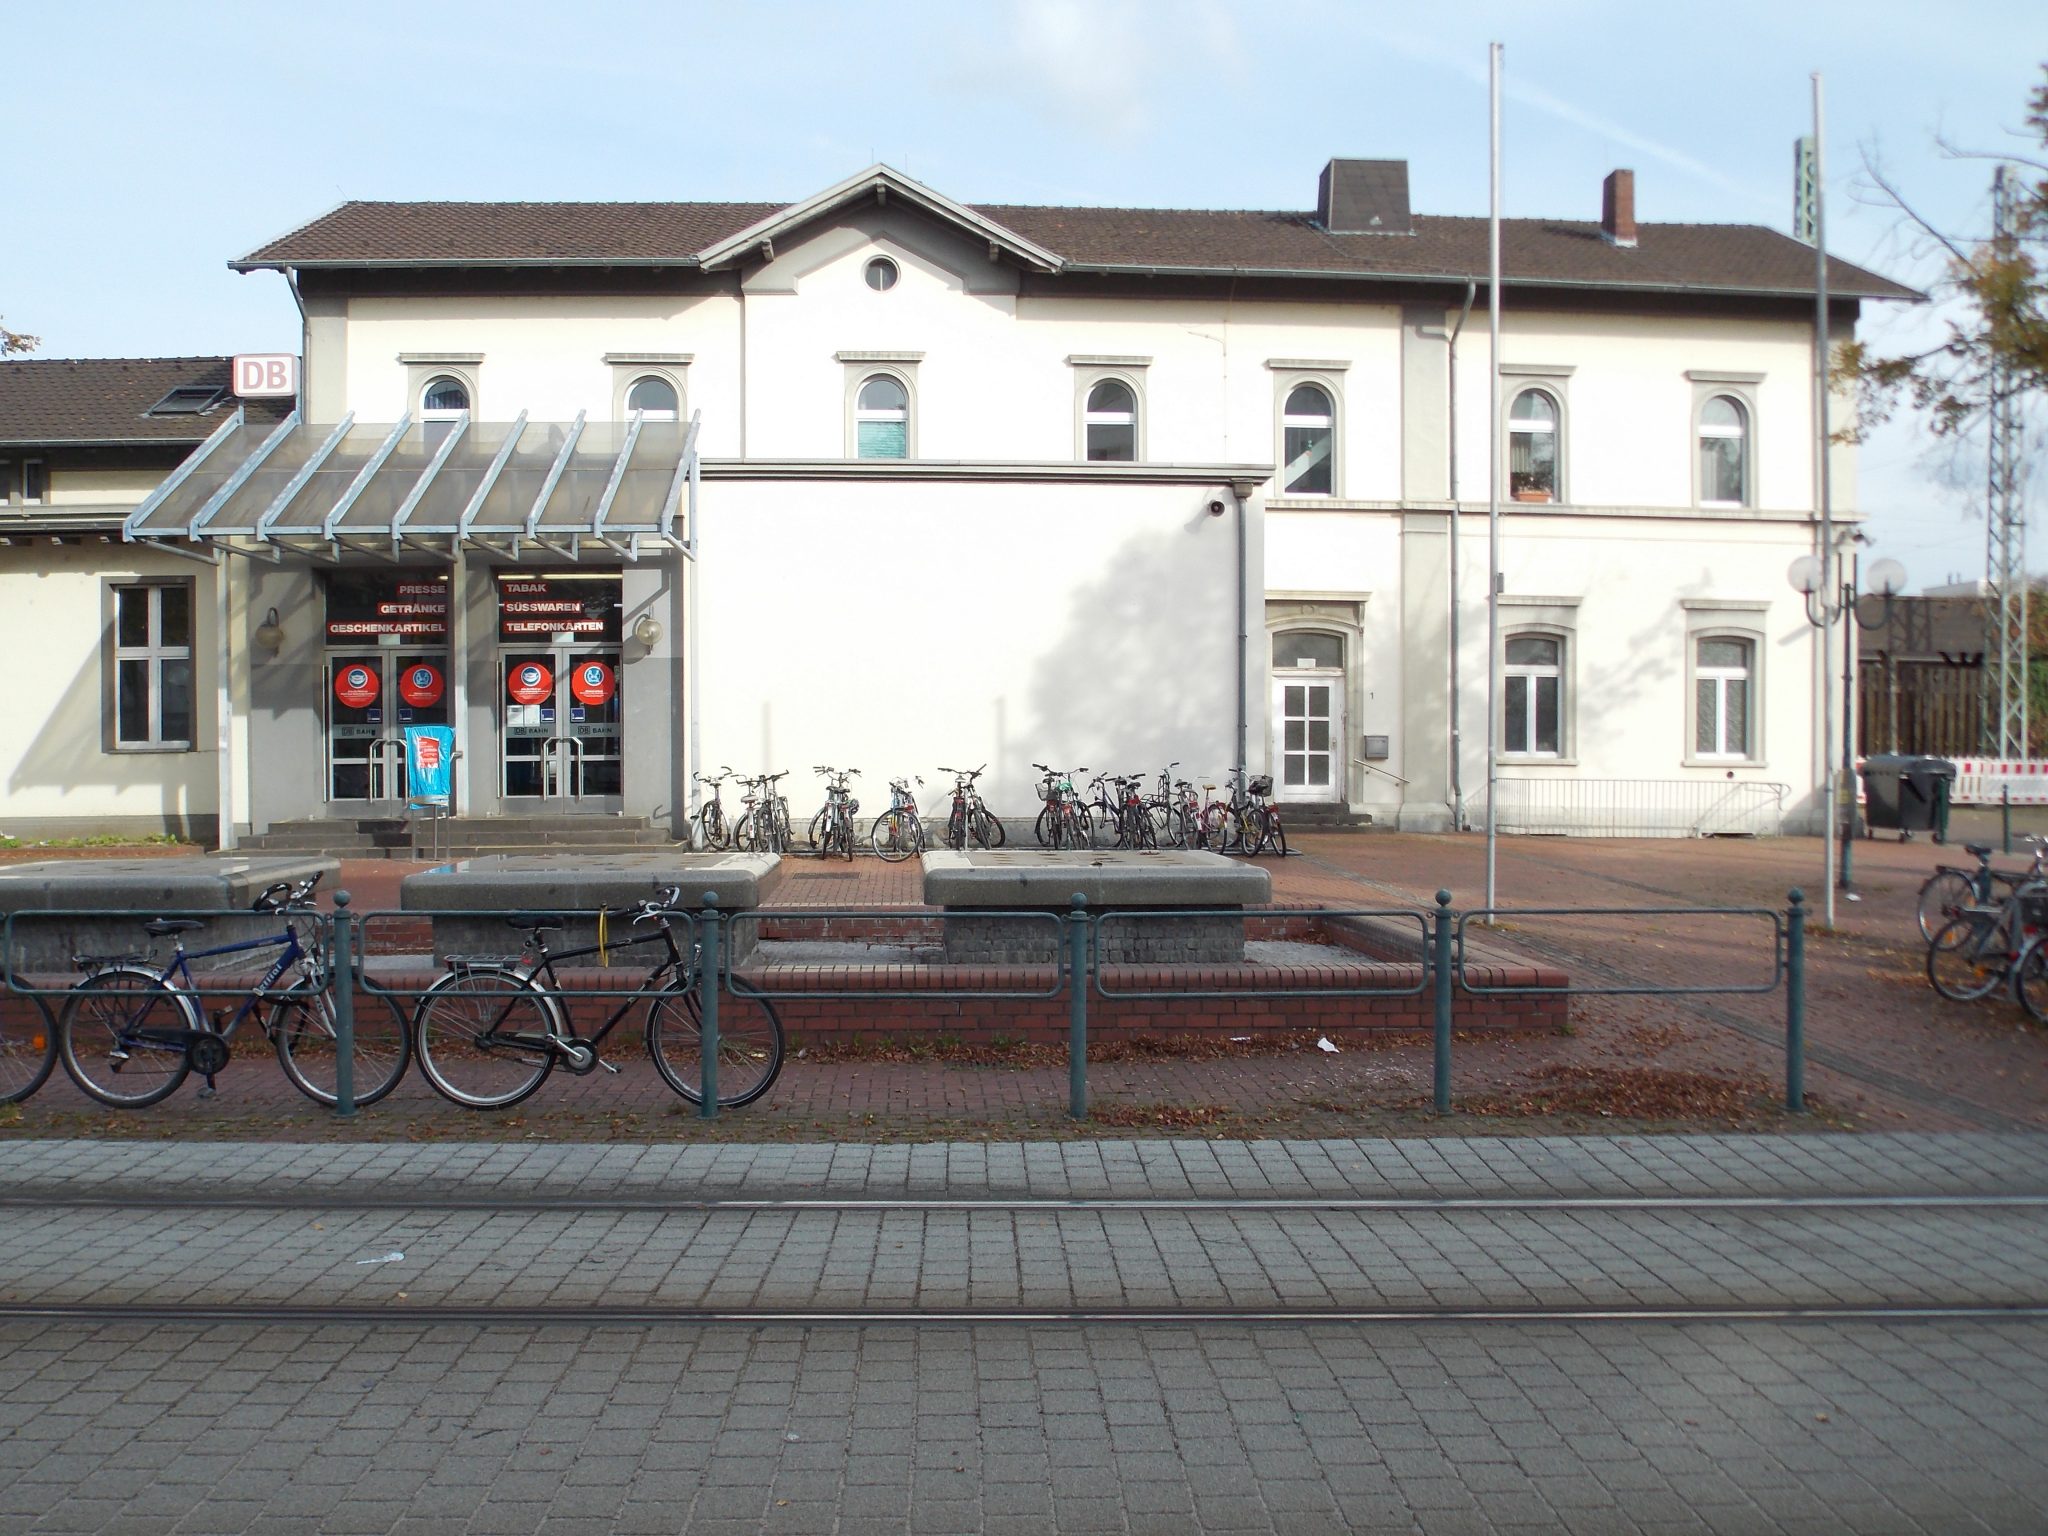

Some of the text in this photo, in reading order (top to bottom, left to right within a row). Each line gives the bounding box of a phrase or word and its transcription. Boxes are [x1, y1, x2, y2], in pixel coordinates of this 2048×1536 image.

[243, 361, 288, 389] DB
[399, 585, 446, 594] PRESSE
[506, 584, 547, 593] TABAK
[380, 603, 446, 614] GETRÄNKE
[506, 602, 580, 612] SÜSSWAREN
[330, 624, 446, 633] GESCHENKARTIKEL
[506, 622, 604, 631] TELEFONKARTEN
[515, 726, 526, 734] DB
[579, 726, 590, 734] DB
